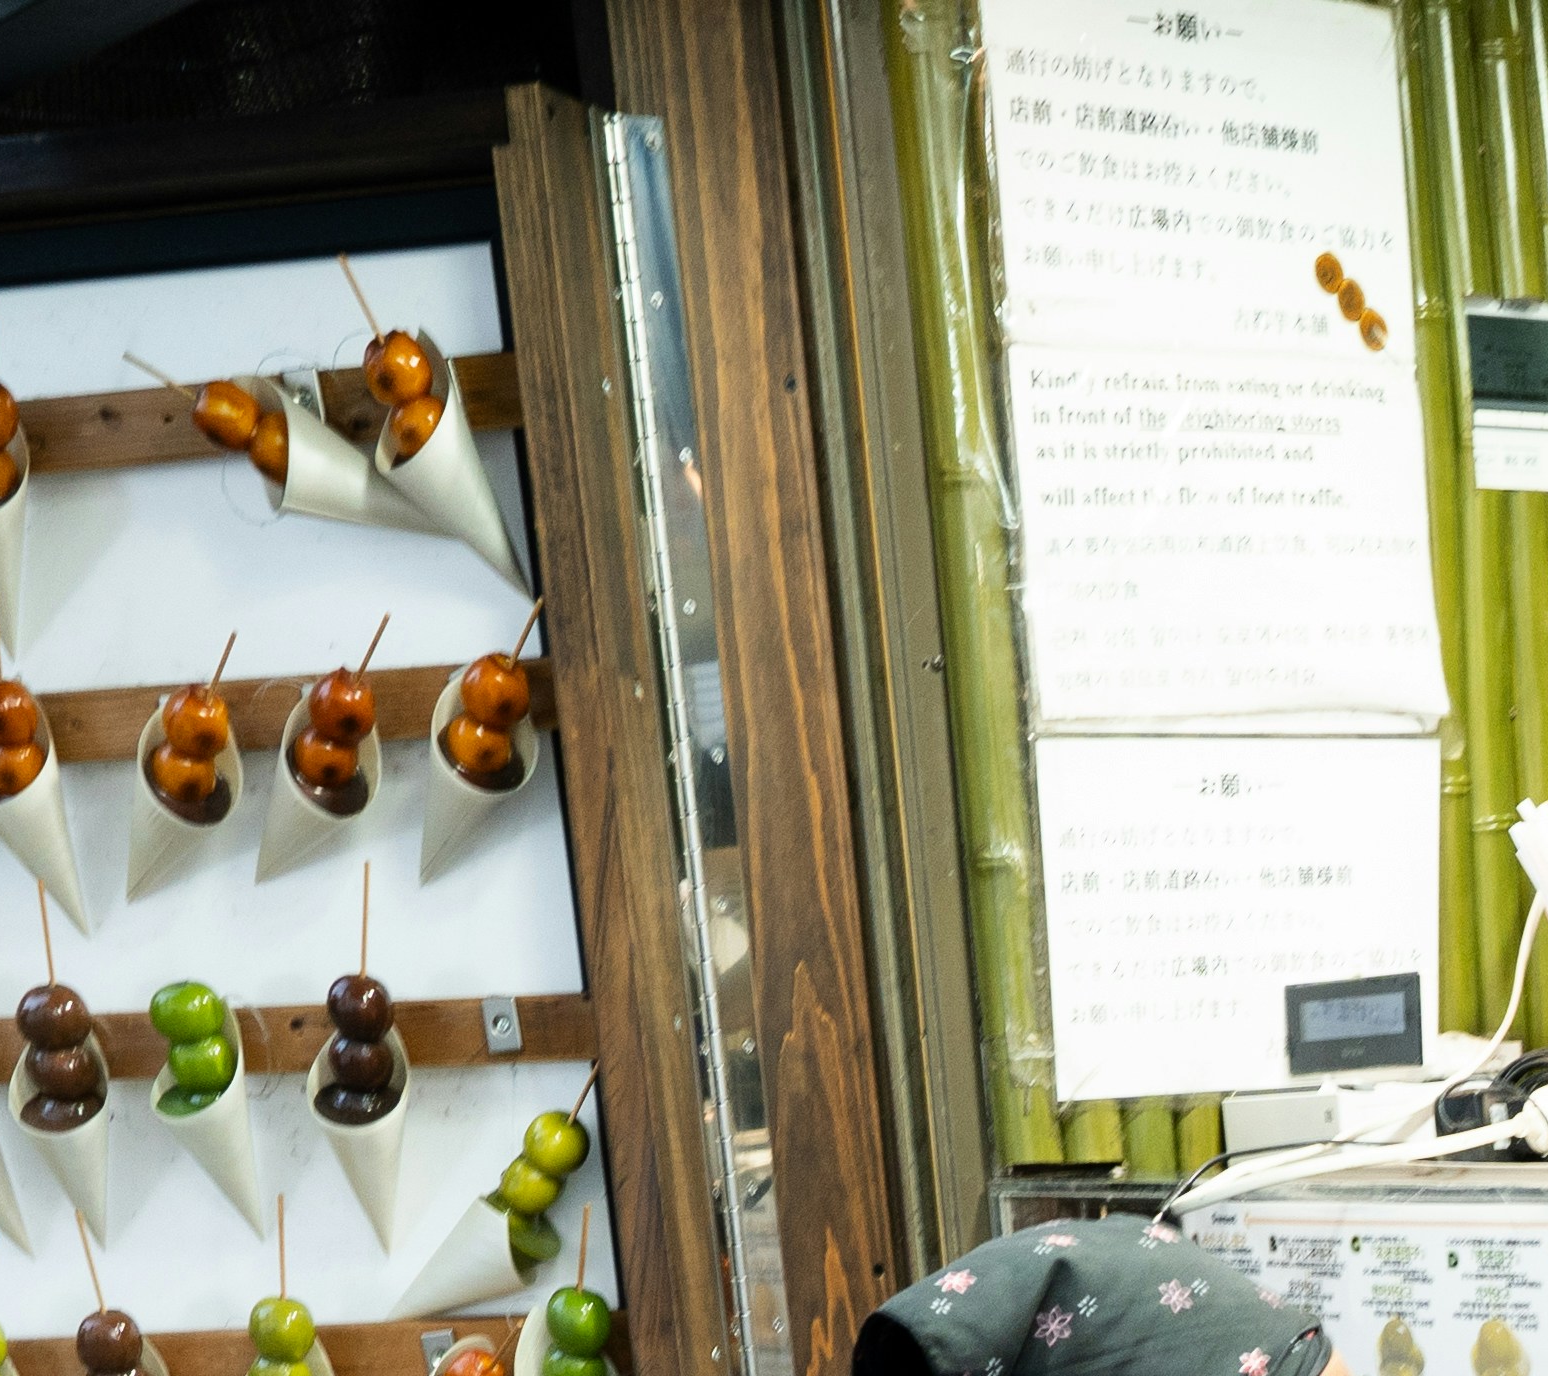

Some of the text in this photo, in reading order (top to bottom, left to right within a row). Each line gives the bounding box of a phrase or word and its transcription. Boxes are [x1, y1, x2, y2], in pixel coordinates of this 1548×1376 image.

[1033, 406, 1050, 425] in
[1058, 405, 1107, 425] front
[1114, 405, 1133, 426] of
[1290, 412, 1341, 433] stores
[1035, 446, 1055, 460] as
[1063, 442, 1076, 460] it
[1083, 442, 1097, 460] is
[1178, 443, 1275, 465] prohibited
[1283, 445, 1315, 462] and
[1041, 488, 1074, 507] will
[1083, 488, 1136, 507] affect
